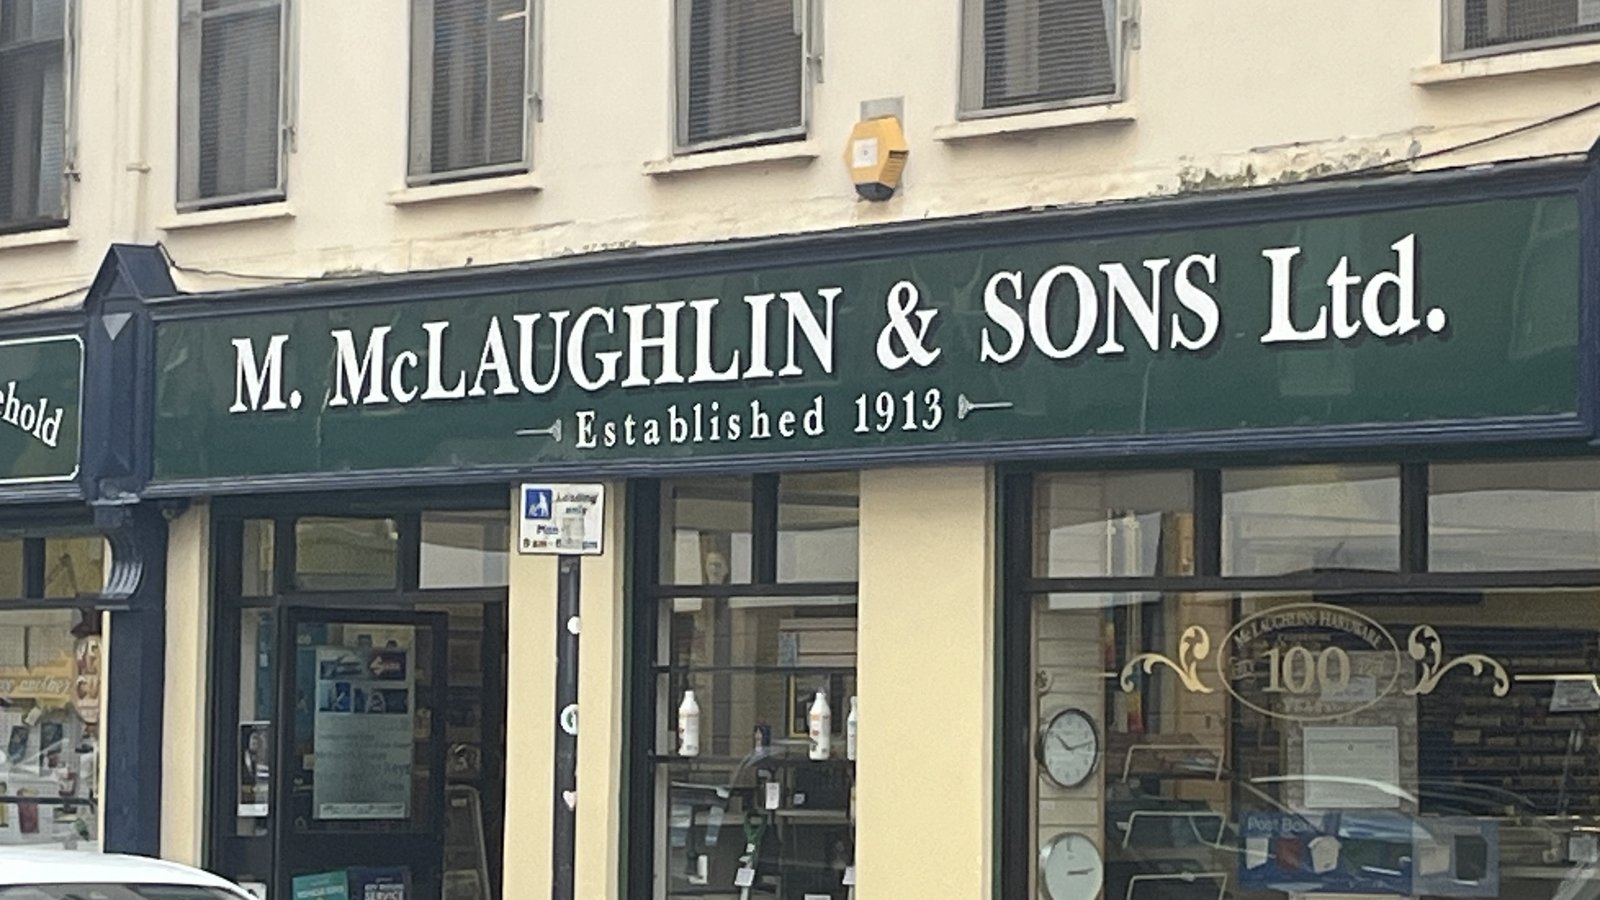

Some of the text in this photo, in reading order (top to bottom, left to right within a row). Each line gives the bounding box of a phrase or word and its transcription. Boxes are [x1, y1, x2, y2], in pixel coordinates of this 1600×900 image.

[230, 234, 1445, 412] M. McLAUGHLIN & SONS Ltd.
[576, 389, 941, 447] Established 1913
[1261, 646, 1351, 694] 100
